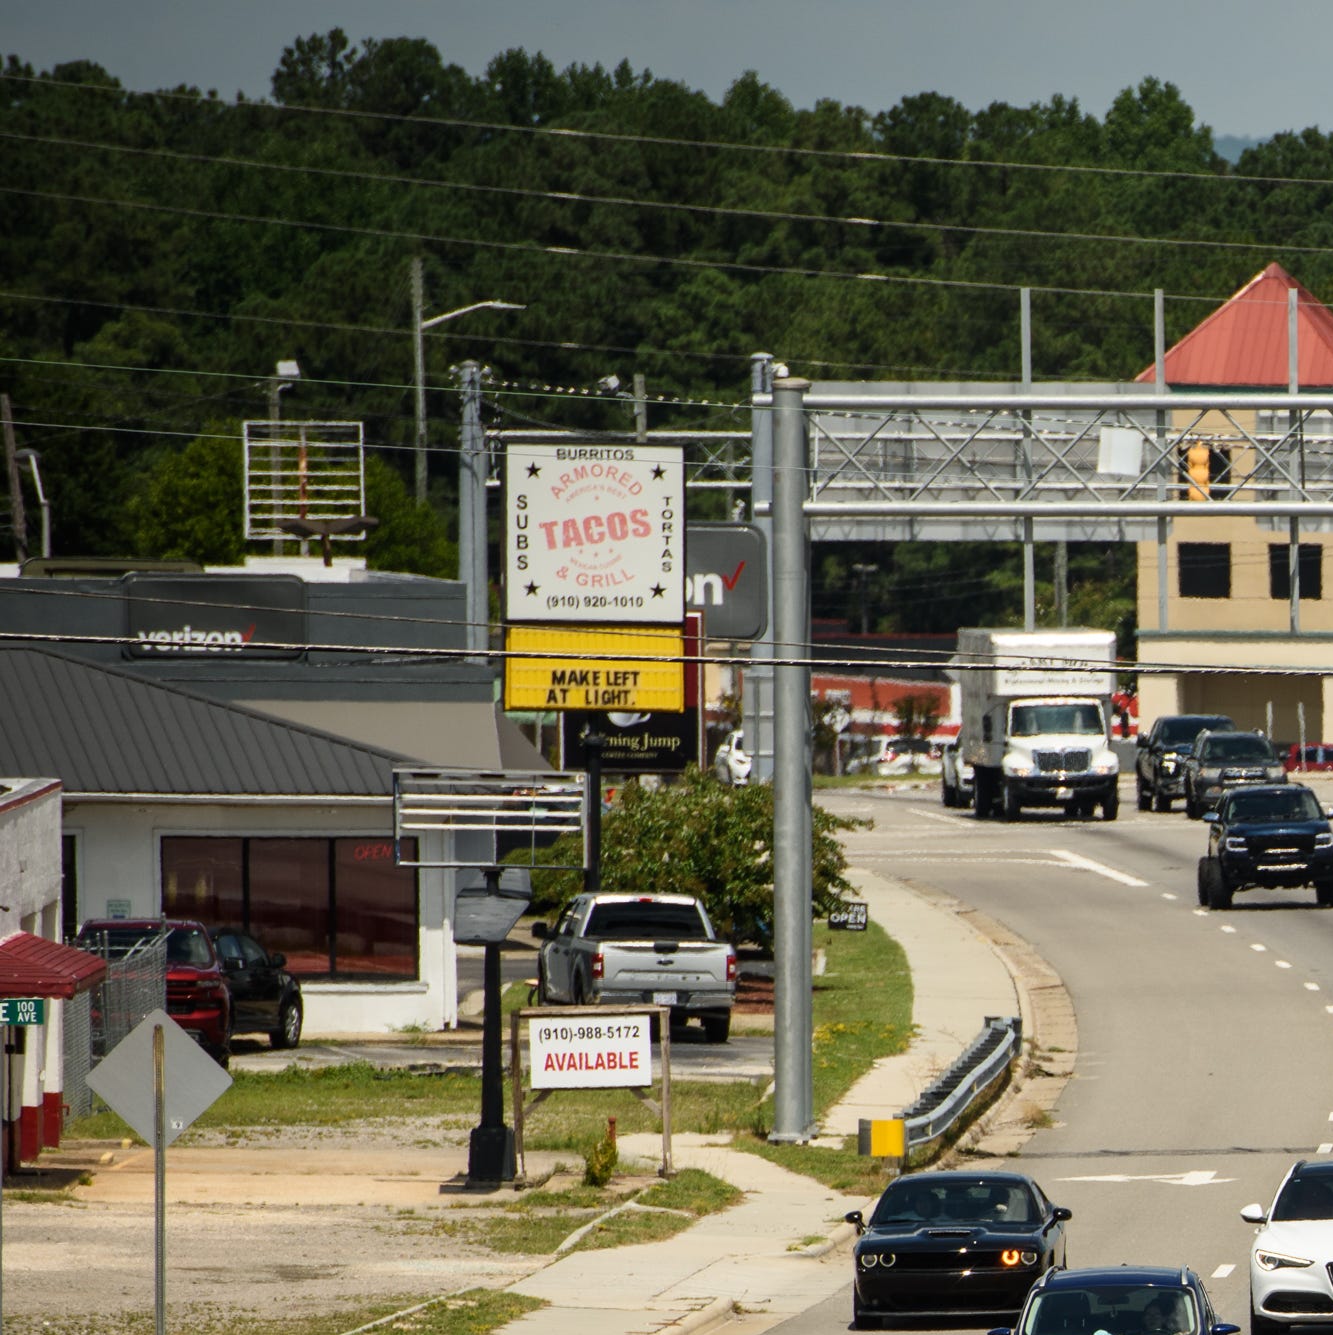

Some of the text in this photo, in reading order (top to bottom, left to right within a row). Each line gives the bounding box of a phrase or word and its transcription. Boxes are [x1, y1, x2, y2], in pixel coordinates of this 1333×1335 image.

[556, 449, 635, 461] BURRITOS
[551, 464, 643, 499] ARMORED
[517, 495, 528, 570] SUBS
[539, 508, 652, 550] TACOS
[661, 496, 673, 572] TORTAS
[556, 566, 635, 588] & GRILL
[546, 595, 644, 609] (910) 920-1010
[552, 670, 640, 686] MAKE LEFT
[546, 688, 568, 704] AT
[640, 732, 681, 751] Jump
[354, 844, 393, 860] OPEN
[830, 912, 866, 923] OPEN
[17, 1001, 35, 1012] 100
[17, 1012, 37, 1022] AVE
[538, 1025, 640, 1044] (910)-988-5172
[544, 1051, 639, 1071] AVAILABLE
